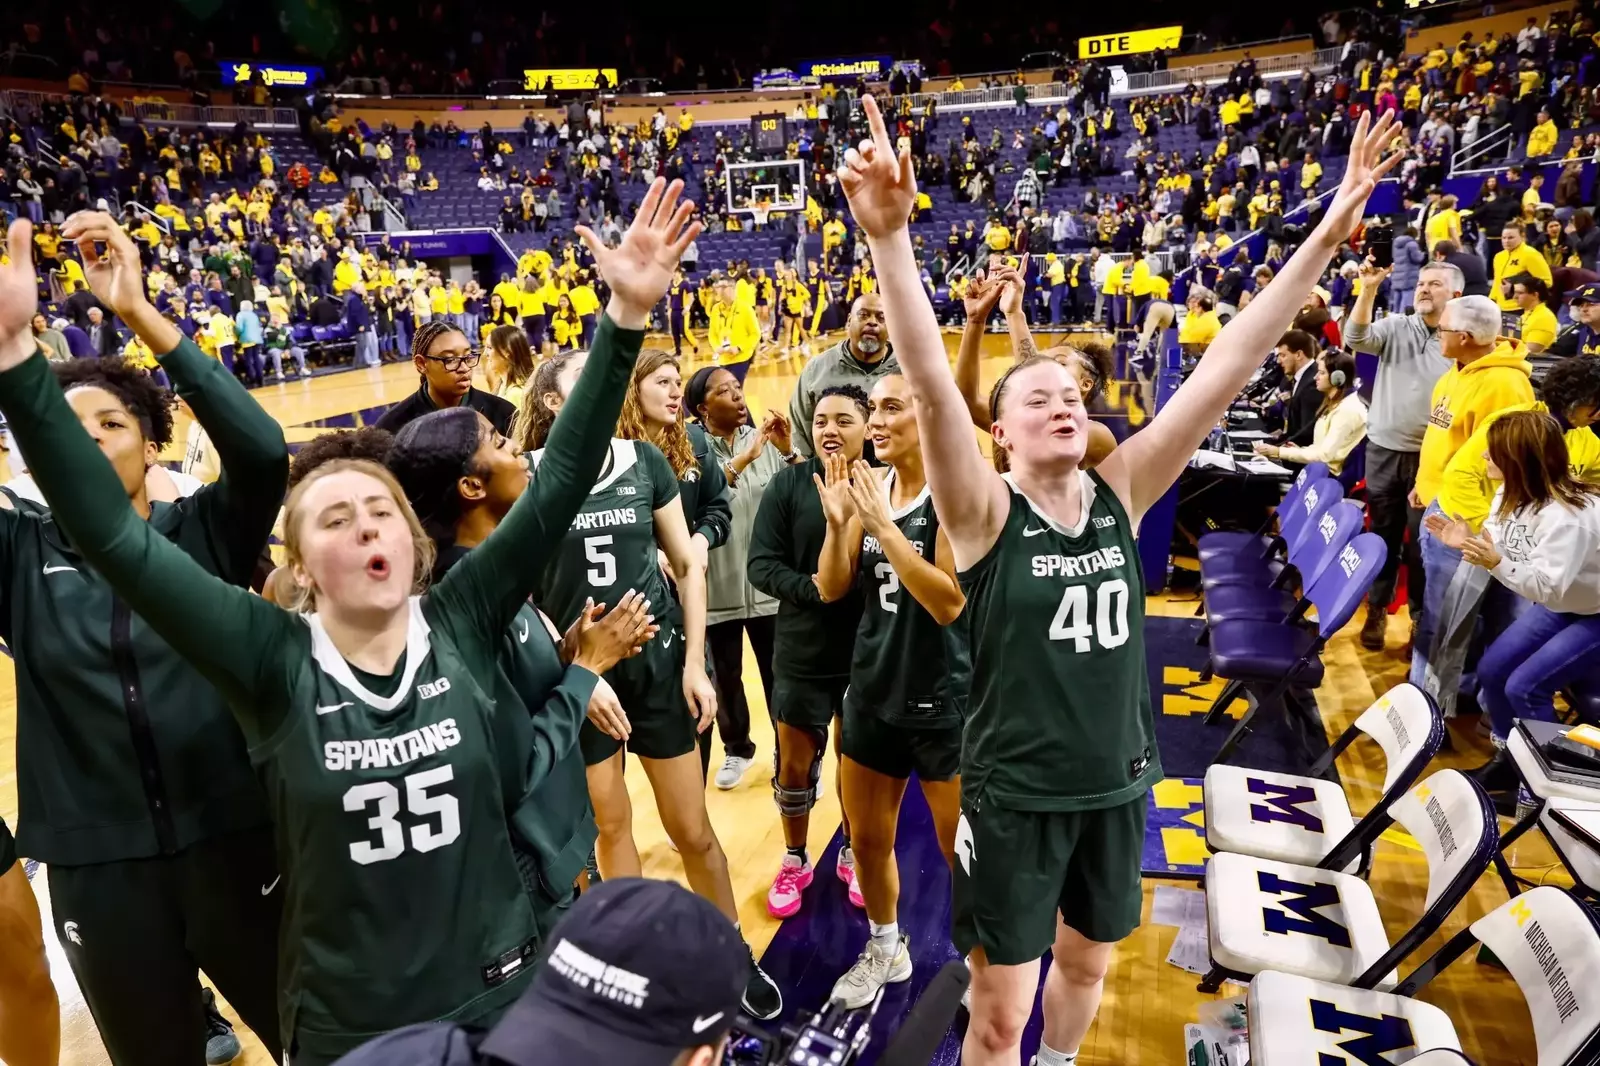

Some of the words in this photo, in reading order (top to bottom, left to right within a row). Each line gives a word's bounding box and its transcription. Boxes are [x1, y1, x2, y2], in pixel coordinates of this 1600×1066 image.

[1089, 36, 1129, 55] DTE
[568, 507, 637, 531] ARTANS
[584, 534, 617, 587] 5
[874, 561, 900, 614] 2
[1031, 545, 1126, 577] SPARTANS
[1048, 578, 1130, 653] 40
[324, 717, 462, 771] SPARTANS
[342, 763, 462, 866] 35
[1246, 776, 1325, 834] M
[1256, 869, 1353, 949] M
[1509, 898, 1532, 928] M
[1524, 920, 1559, 977] MICHIGAN
[1547, 966, 1580, 1024] MEDICINE
[1308, 998, 1416, 1066] M
